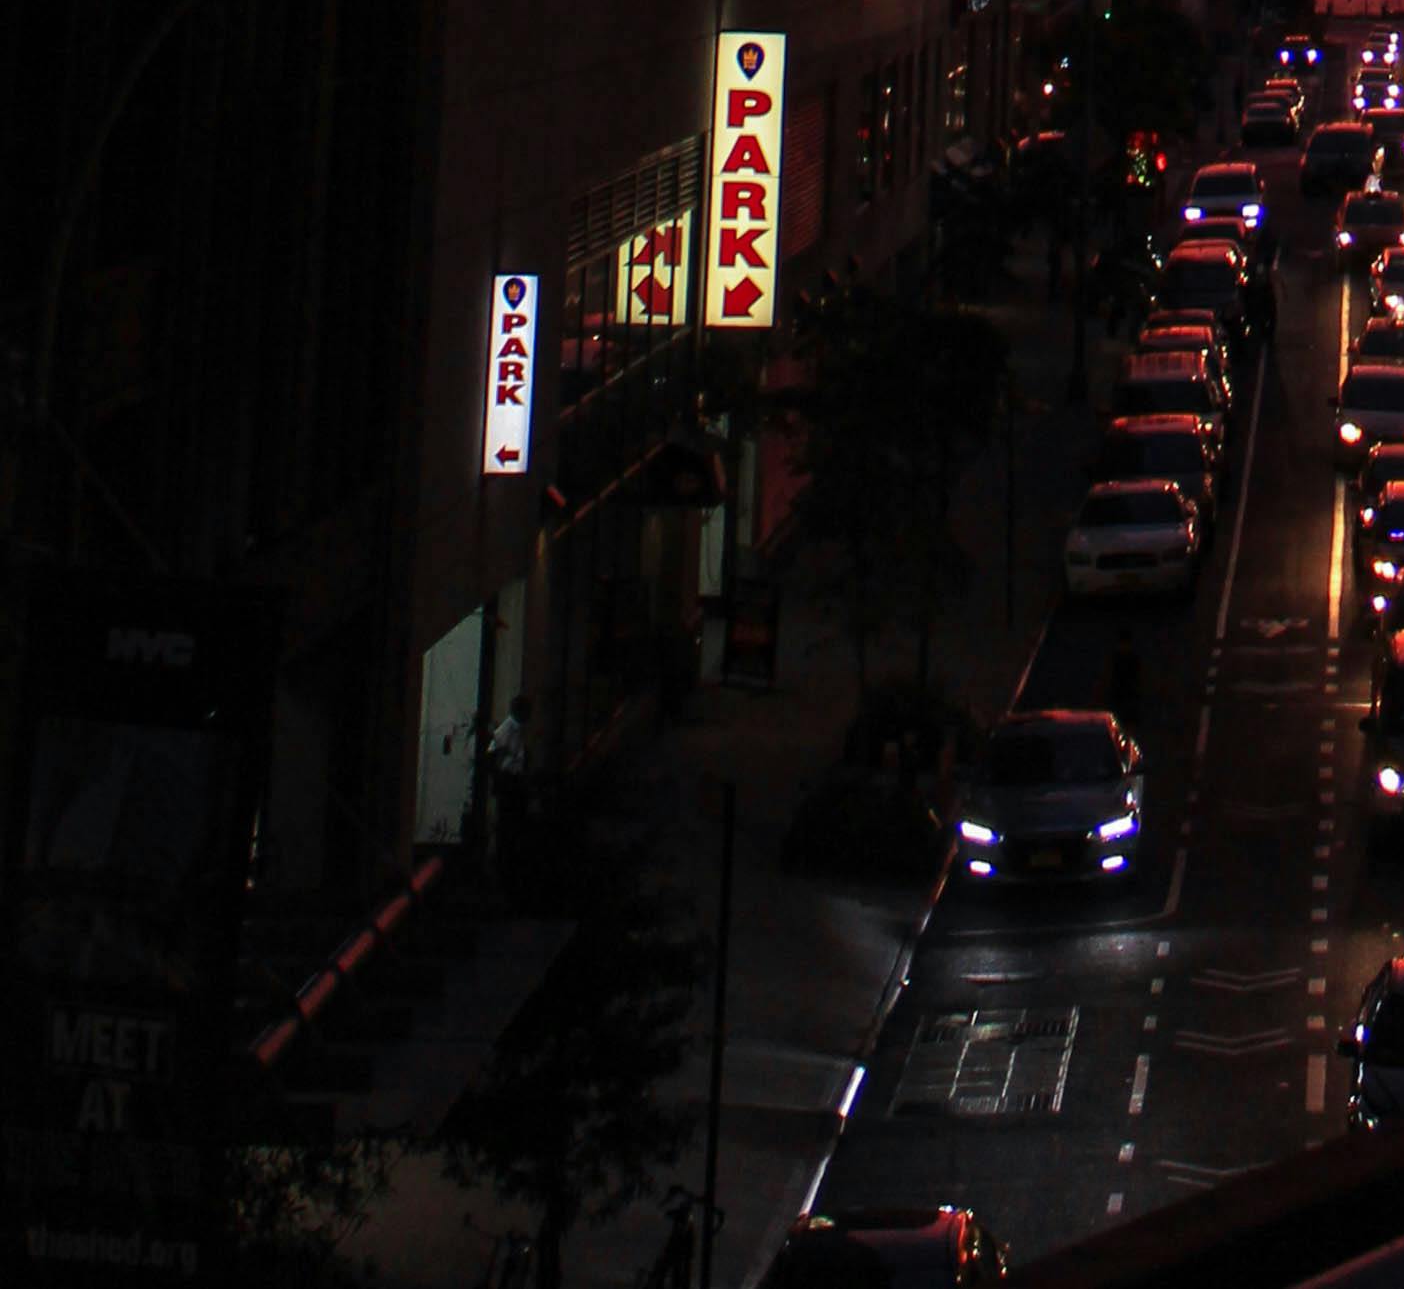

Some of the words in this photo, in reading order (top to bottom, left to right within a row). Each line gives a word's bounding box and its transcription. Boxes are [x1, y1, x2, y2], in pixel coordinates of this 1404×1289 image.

[717, 89, 772, 269] PARK
[496, 313, 528, 406] PARK
[51, 1009, 168, 1073] MEET
[76, 1079, 132, 1132] AT
